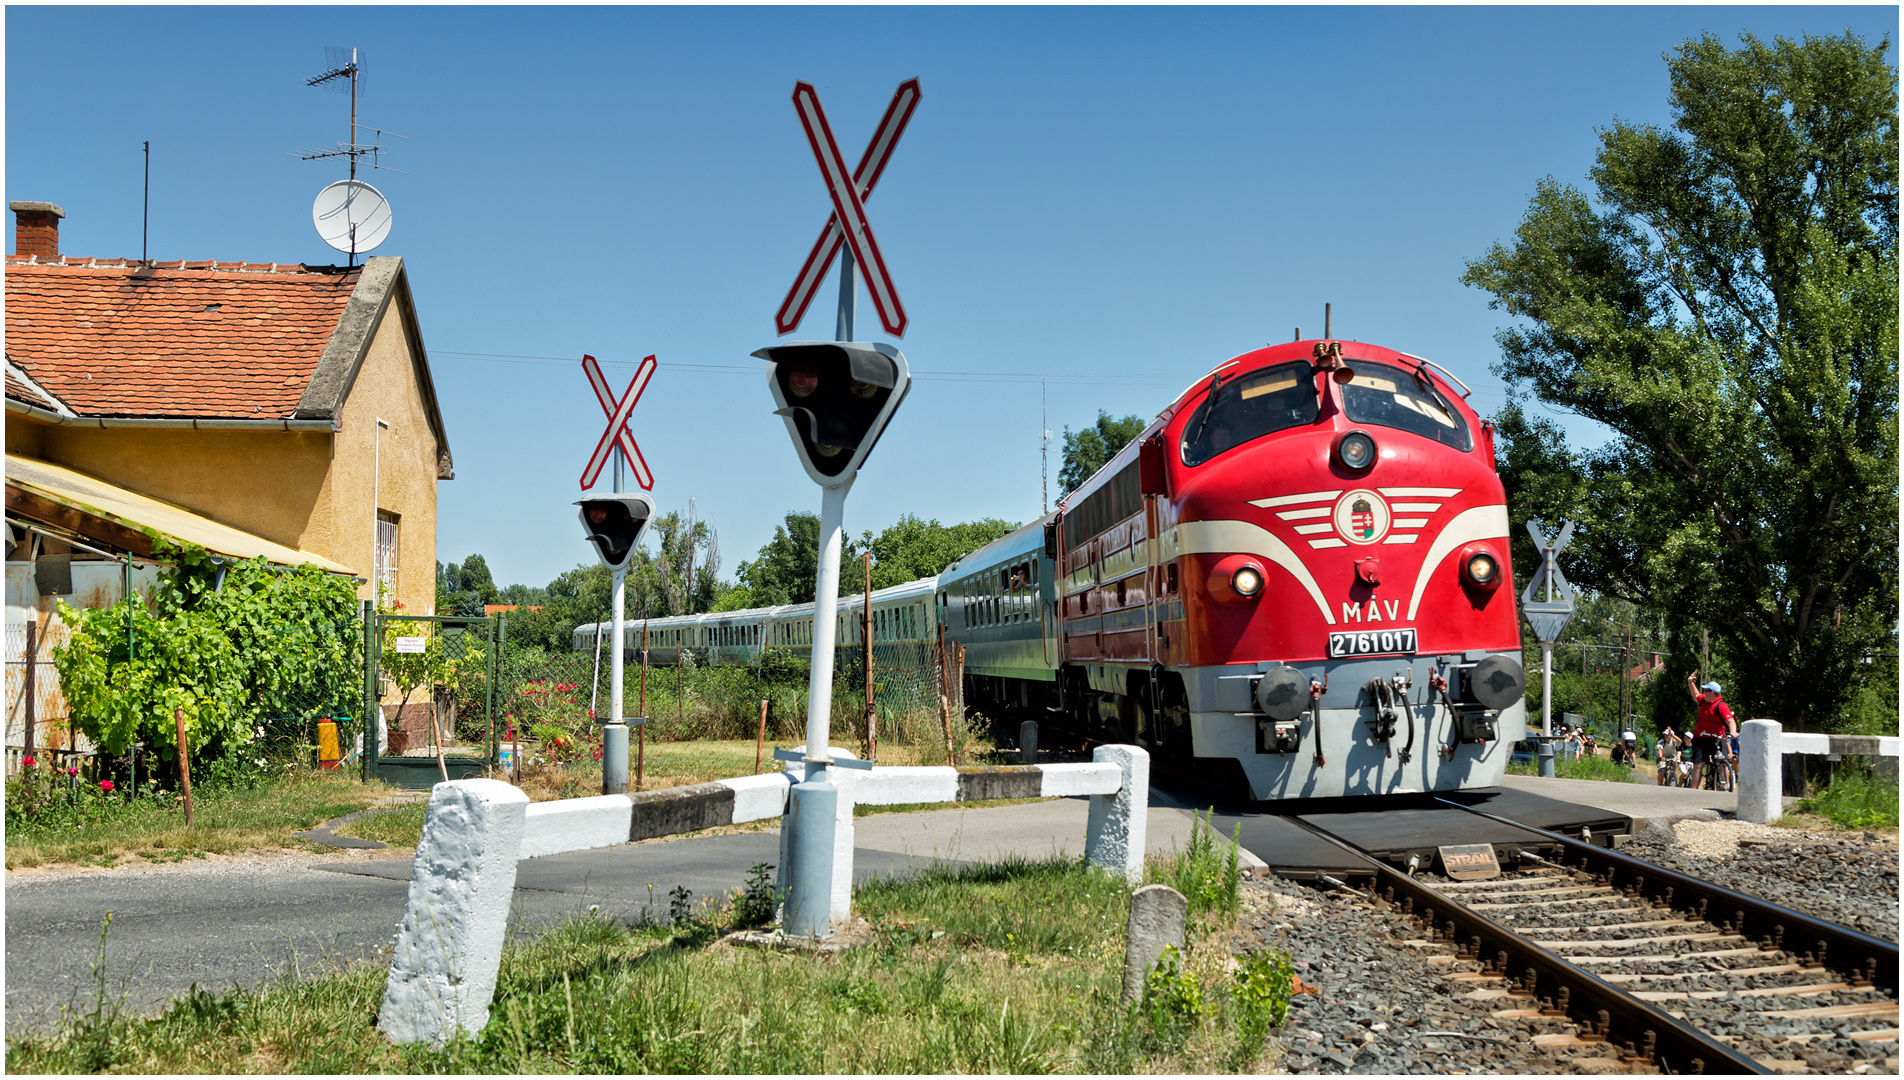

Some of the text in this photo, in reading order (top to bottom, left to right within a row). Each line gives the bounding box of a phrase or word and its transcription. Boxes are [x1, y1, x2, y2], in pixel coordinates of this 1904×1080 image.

[1342, 594, 1400, 624] MÁV
[1332, 630, 1414, 655] 2761017
[1444, 853, 1495, 866] STRAIL
